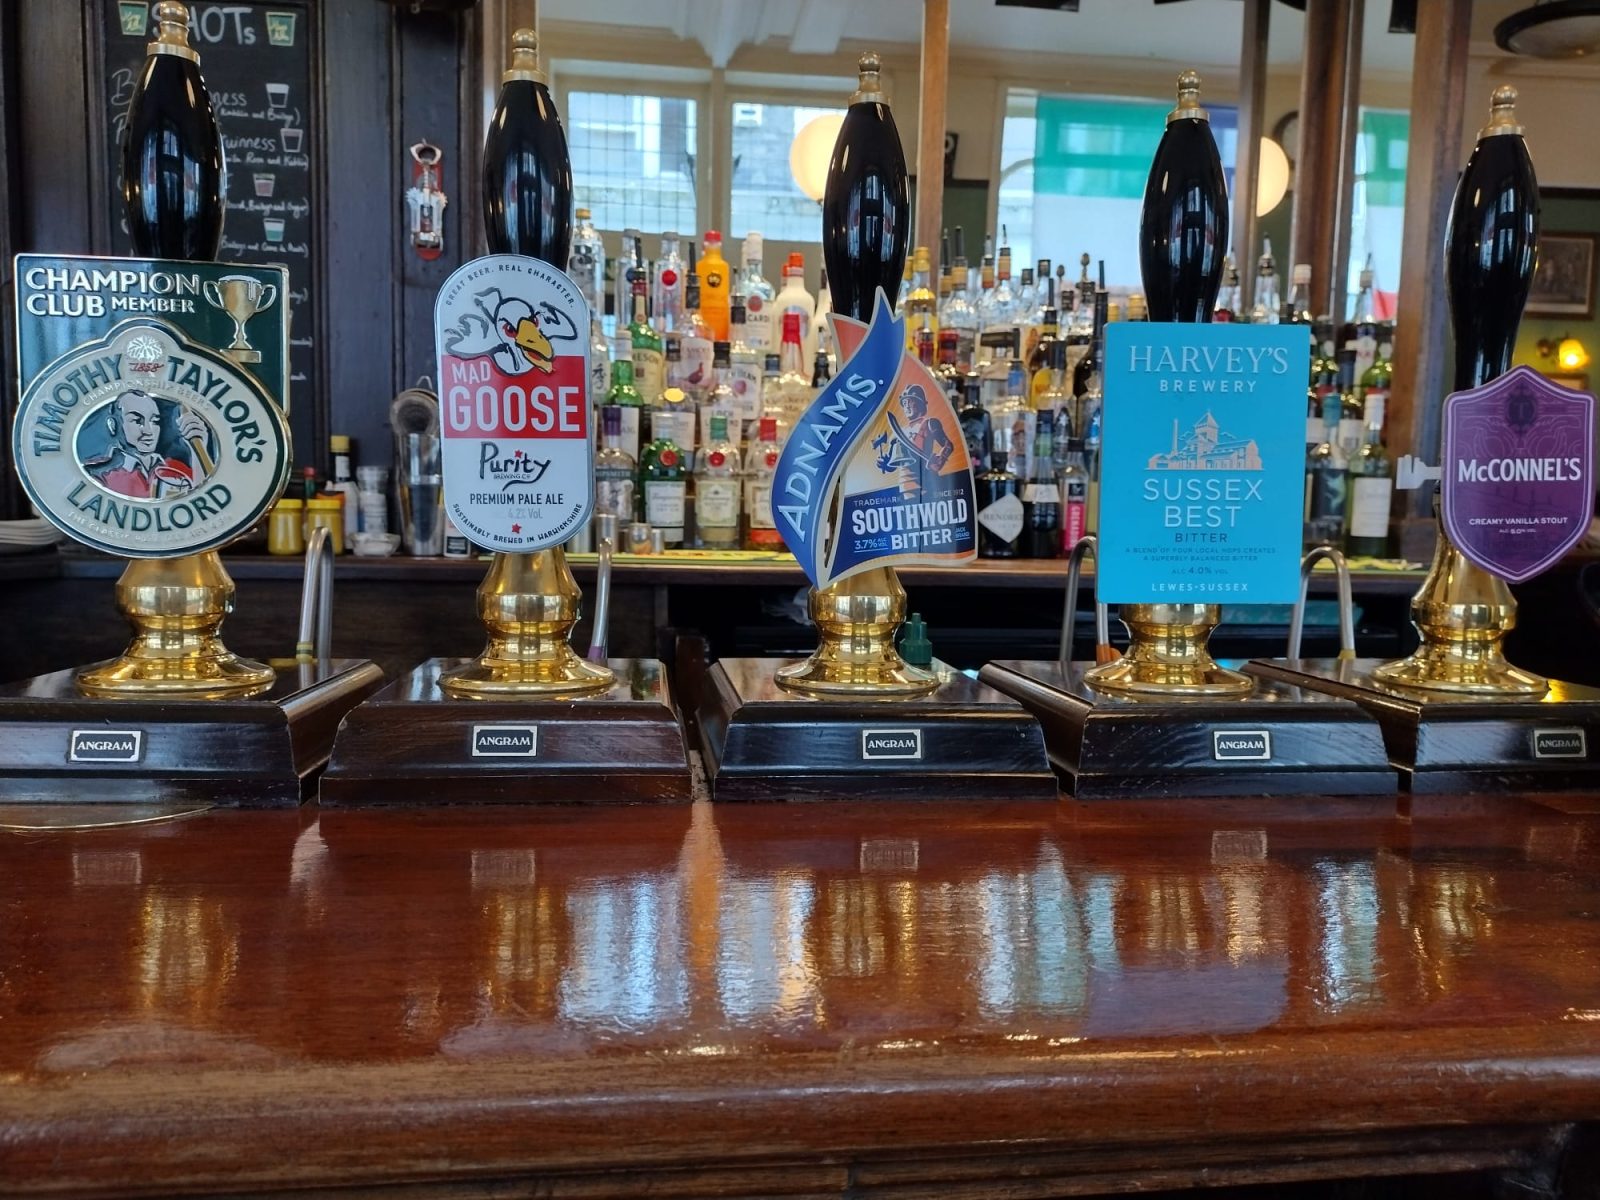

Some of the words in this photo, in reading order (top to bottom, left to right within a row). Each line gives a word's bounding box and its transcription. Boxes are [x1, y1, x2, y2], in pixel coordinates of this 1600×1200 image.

[25, 267, 200, 296] CHAMPION
[445, 280, 466, 306] GREAT
[498, 264, 522, 272] REAL
[26, 293, 106, 318] CLUB
[112, 297, 195, 314] MEMBER
[128, 362, 165, 373] 1858
[1128, 345, 1288, 375] HARVEY'S
[452, 360, 491, 384] MAD
[1159, 380, 1257, 393] BREWERY
[33, 353, 122, 457] TIMOTHY
[167, 355, 268, 463] TAYLOR'S
[448, 385, 580, 432] GOOSE
[479, 441, 552, 491] Purity
[1458, 457, 1581, 482] McCONNEL'S
[470, 493, 515, 505] PREMIUM
[518, 493, 542, 505] PALE
[545, 493, 564, 505] ALE
[1143, 478, 1263, 501] SUSSEX
[66, 480, 232, 532] LANDLORD
[854, 496, 900, 507] TRADEMAR
[453, 503, 491, 539] SUSTAINABLY
[493, 535, 523, 544] BREWED
[538, 503, 583, 540] WARWICKSHIRE
[852, 498, 968, 535] SOUTHWOLD
[1164, 505, 1241, 528] BEST
[1505, 517, 1539, 525] VANILLA
[854, 538, 877, 550] 3.7%
[891, 528, 952, 550] BITTER
[1175, 533, 1228, 543] BITTER
[77, 741, 133, 750] ANGRAM
[479, 736, 531, 745] ANGRAM
[868, 740, 915, 748] ANGRAM
[1219, 741, 1264, 749] ANGRAM
[1540, 740, 1579, 748] ANGRAM
